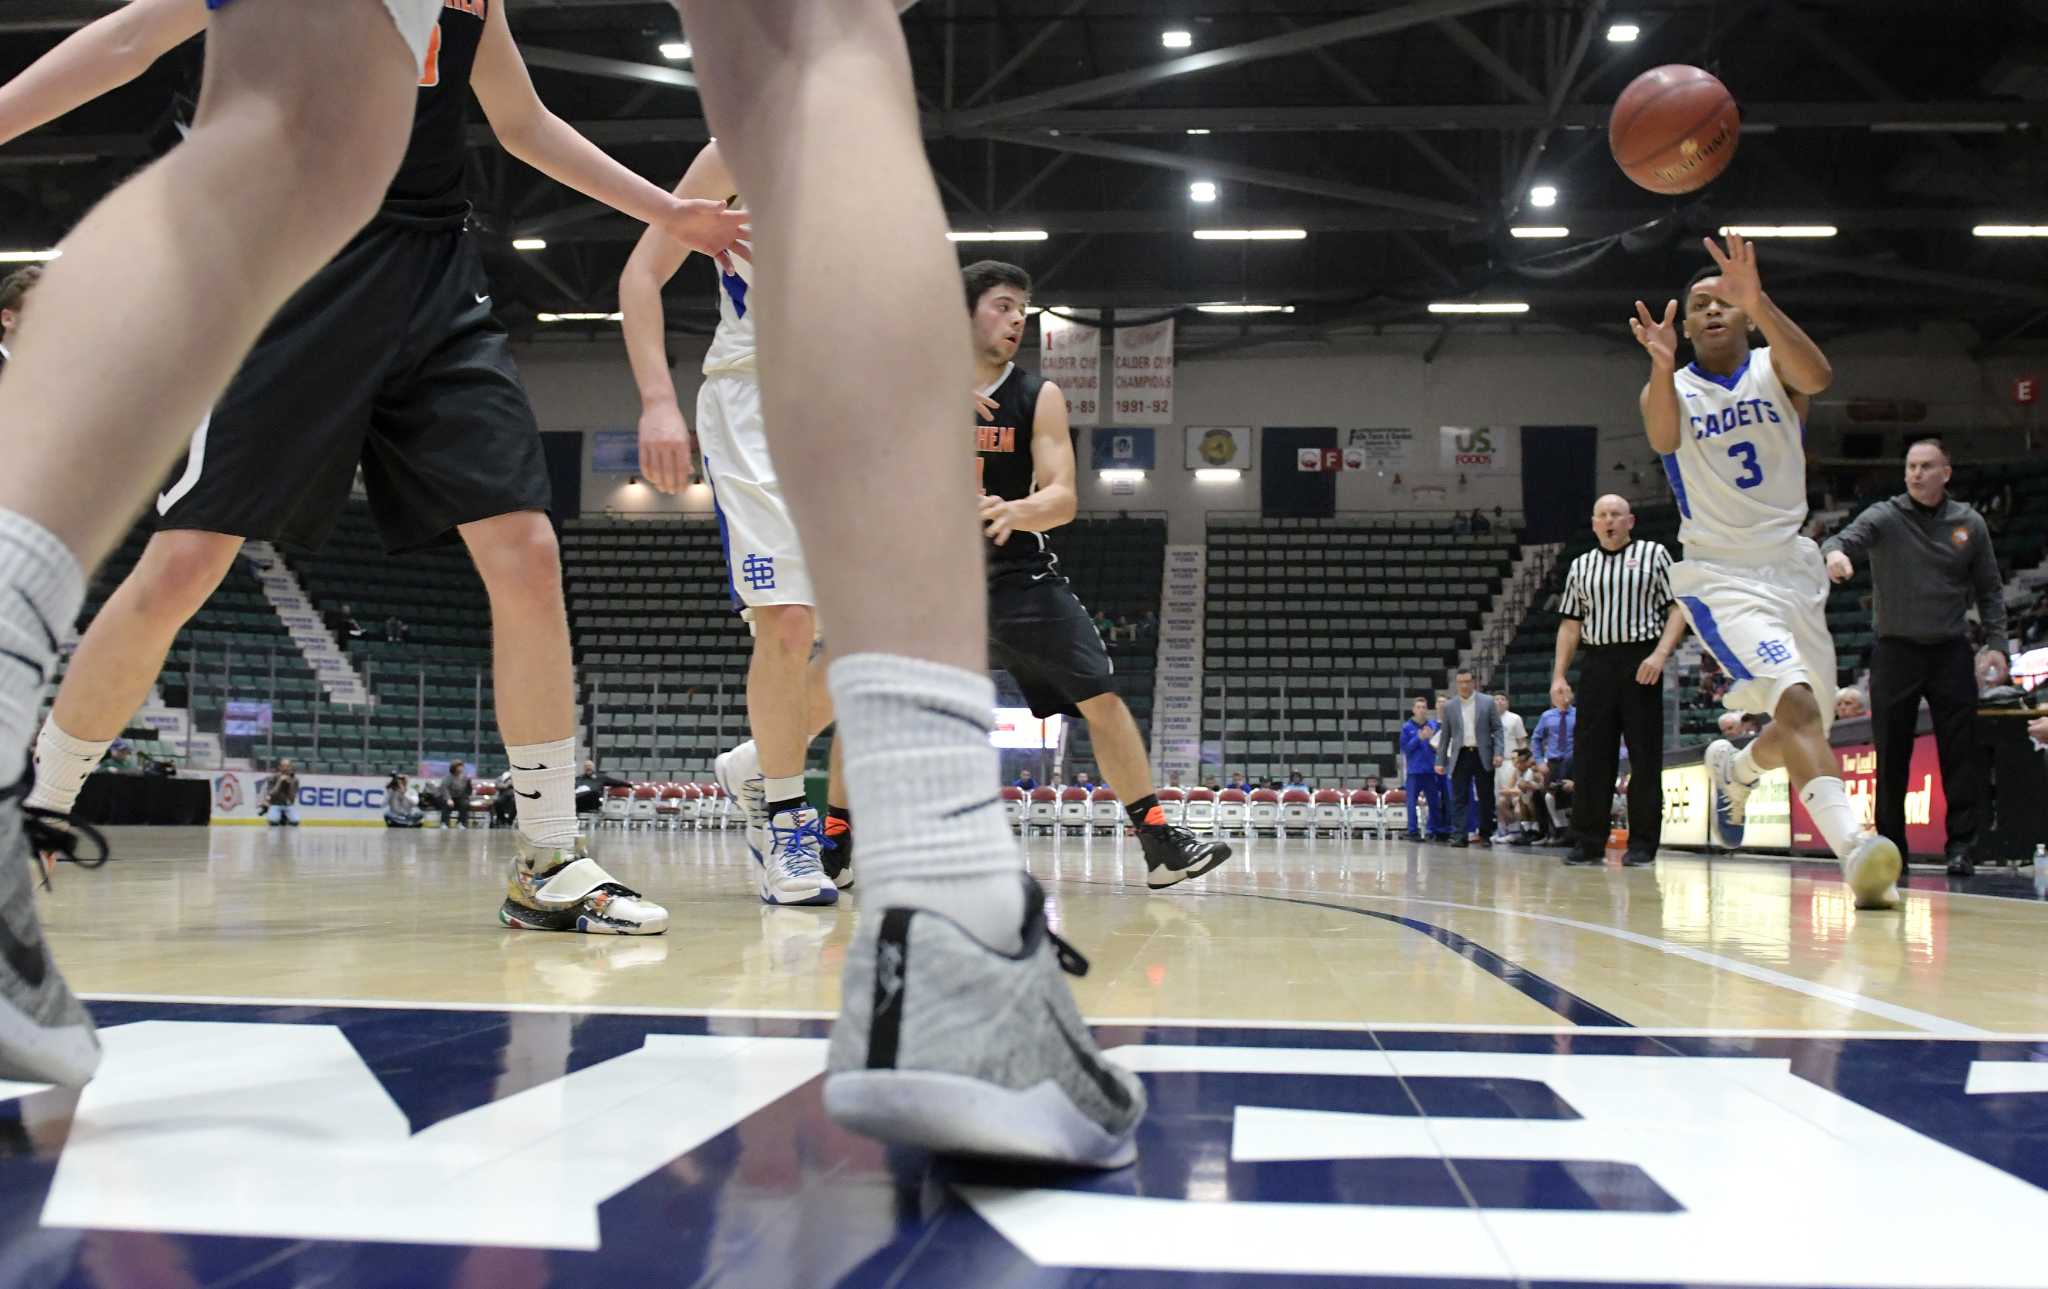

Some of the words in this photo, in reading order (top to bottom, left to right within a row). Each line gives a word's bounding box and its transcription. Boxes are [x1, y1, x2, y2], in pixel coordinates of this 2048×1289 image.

[1115, 356, 1150, 369] CALDER
[1116, 376, 1171, 389] CHAMPIONS
[2018, 381, 2032, 400] E
[1690, 398, 1781, 440] CADETS
[1326, 452, 1337, 468] F
[1727, 441, 1764, 489] 3
